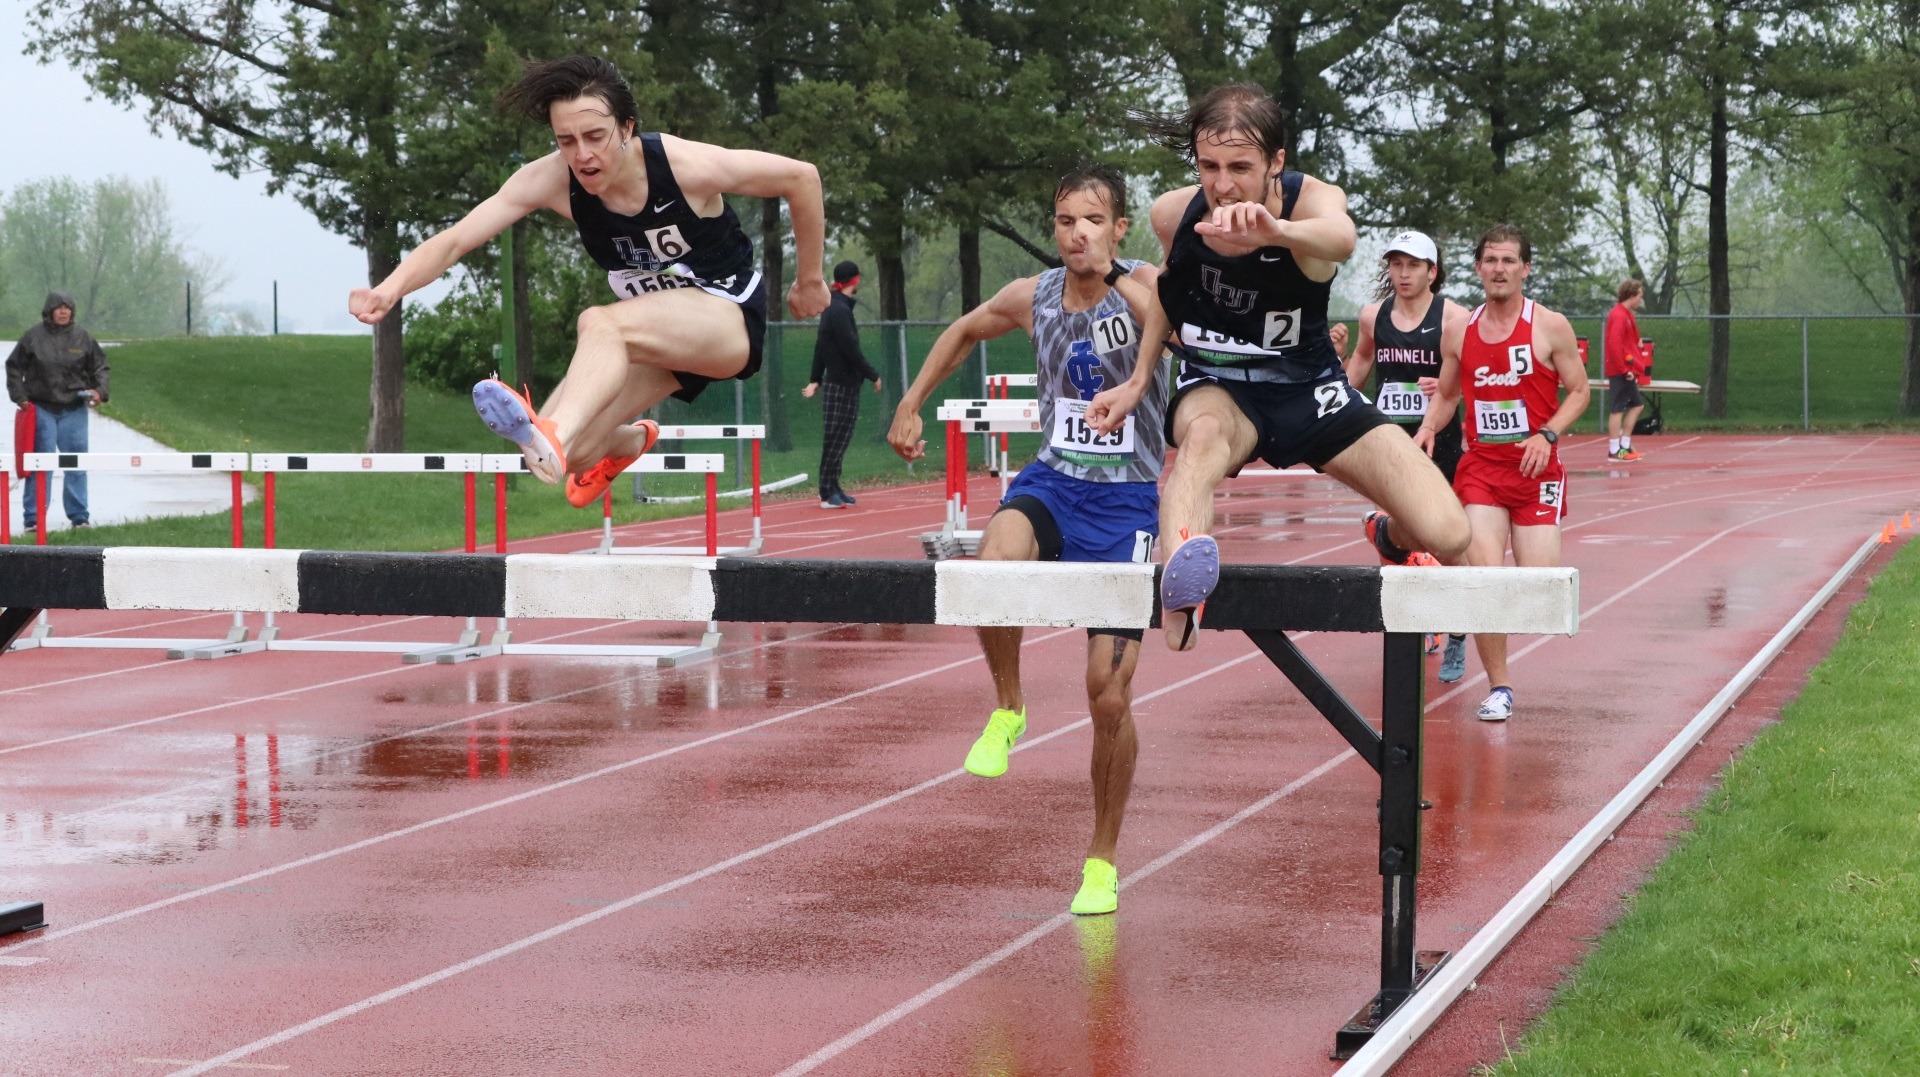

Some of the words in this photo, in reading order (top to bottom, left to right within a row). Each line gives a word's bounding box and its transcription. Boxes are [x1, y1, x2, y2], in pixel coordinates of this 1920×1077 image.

[656, 229, 683, 258] 6
[1098, 316, 1129, 350] 10
[1270, 314, 1294, 347] 2
[1377, 348, 1437, 365] GRINNELL
[1515, 347, 1528, 375] 5
[1320, 386, 1343, 413] 2
[1382, 393, 1423, 411] 1509
[1481, 411, 1520, 430] 1591
[1545, 483, 1556, 505] 5
